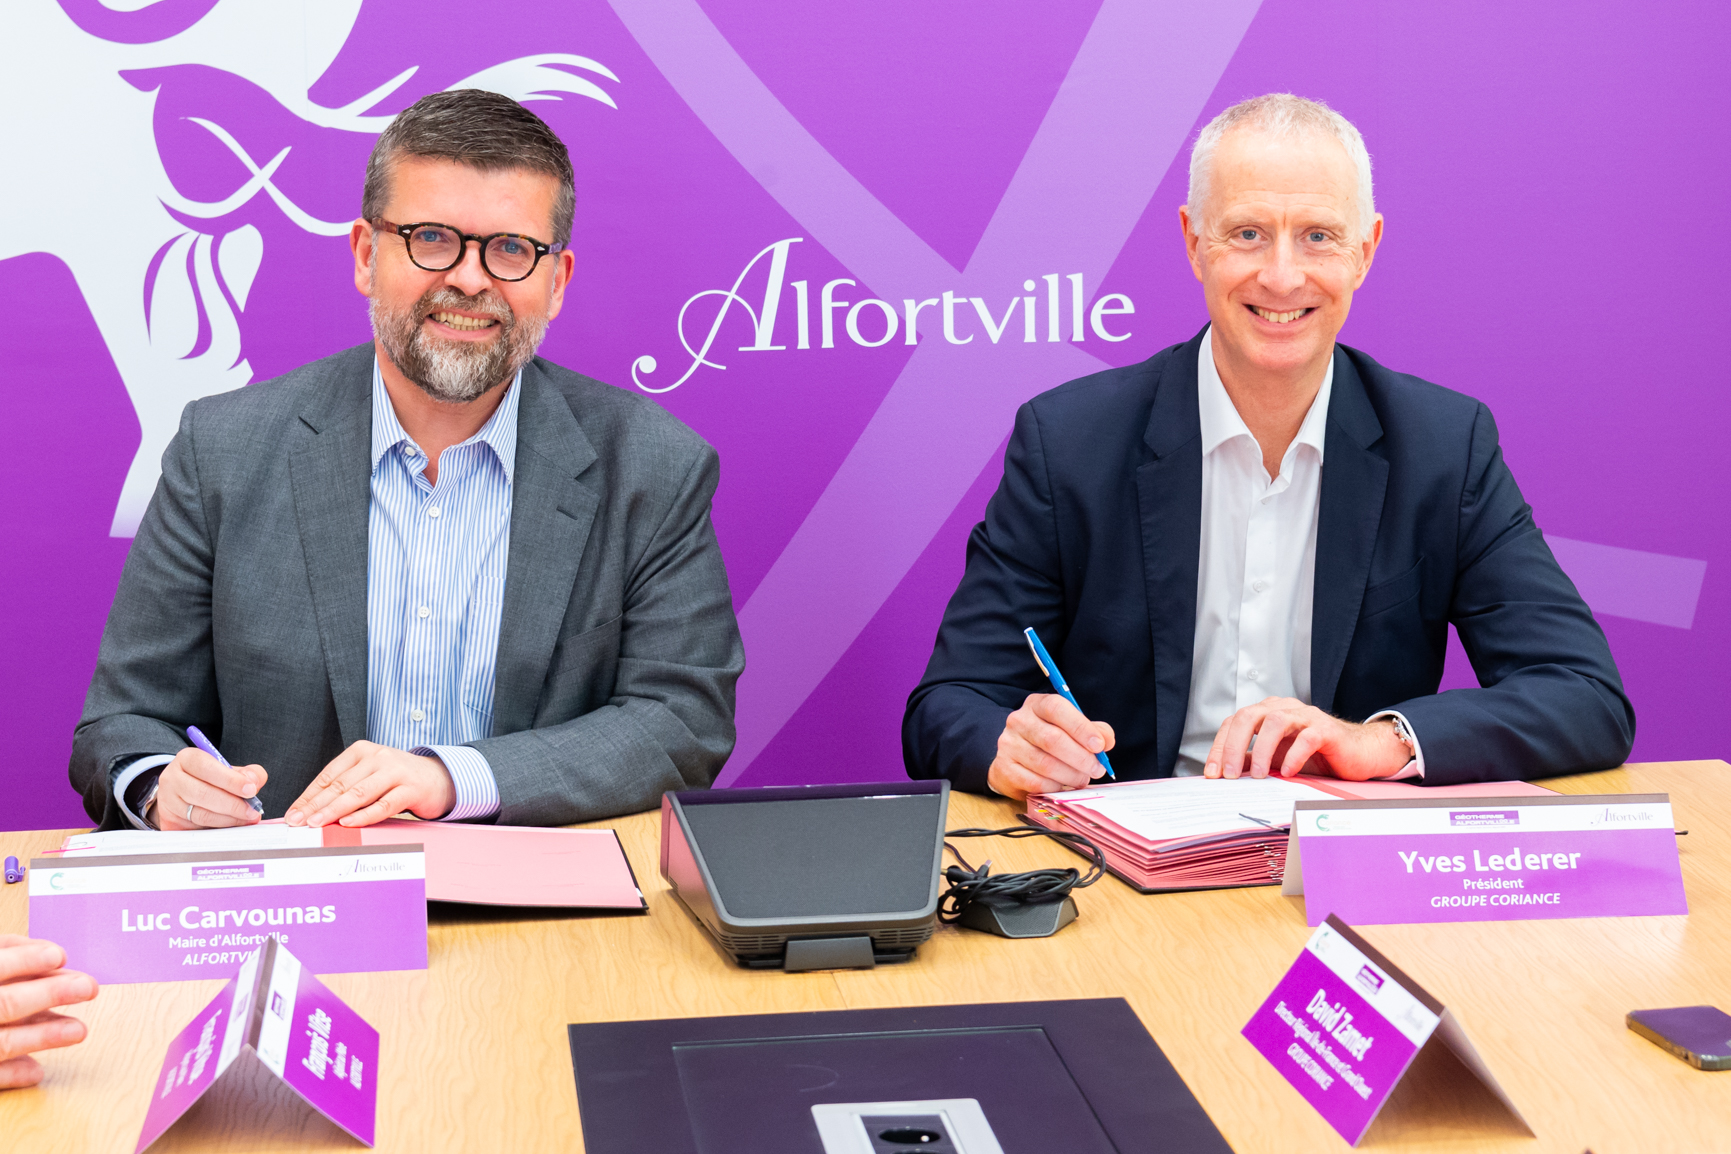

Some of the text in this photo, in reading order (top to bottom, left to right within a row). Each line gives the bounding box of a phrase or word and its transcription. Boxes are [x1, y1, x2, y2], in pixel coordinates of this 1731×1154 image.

[631, 236, 1136, 394] Alfortville
[1590, 808, 1653, 827] Alfortville
[1398, 848, 1581, 874] Yves Lederer
[1463, 878, 1524, 890] Président
[1431, 893, 1561, 908] GROUPE CORIANCE
[122, 904, 336, 932] Luc Carvounas
[169, 936, 206, 948] Maire
